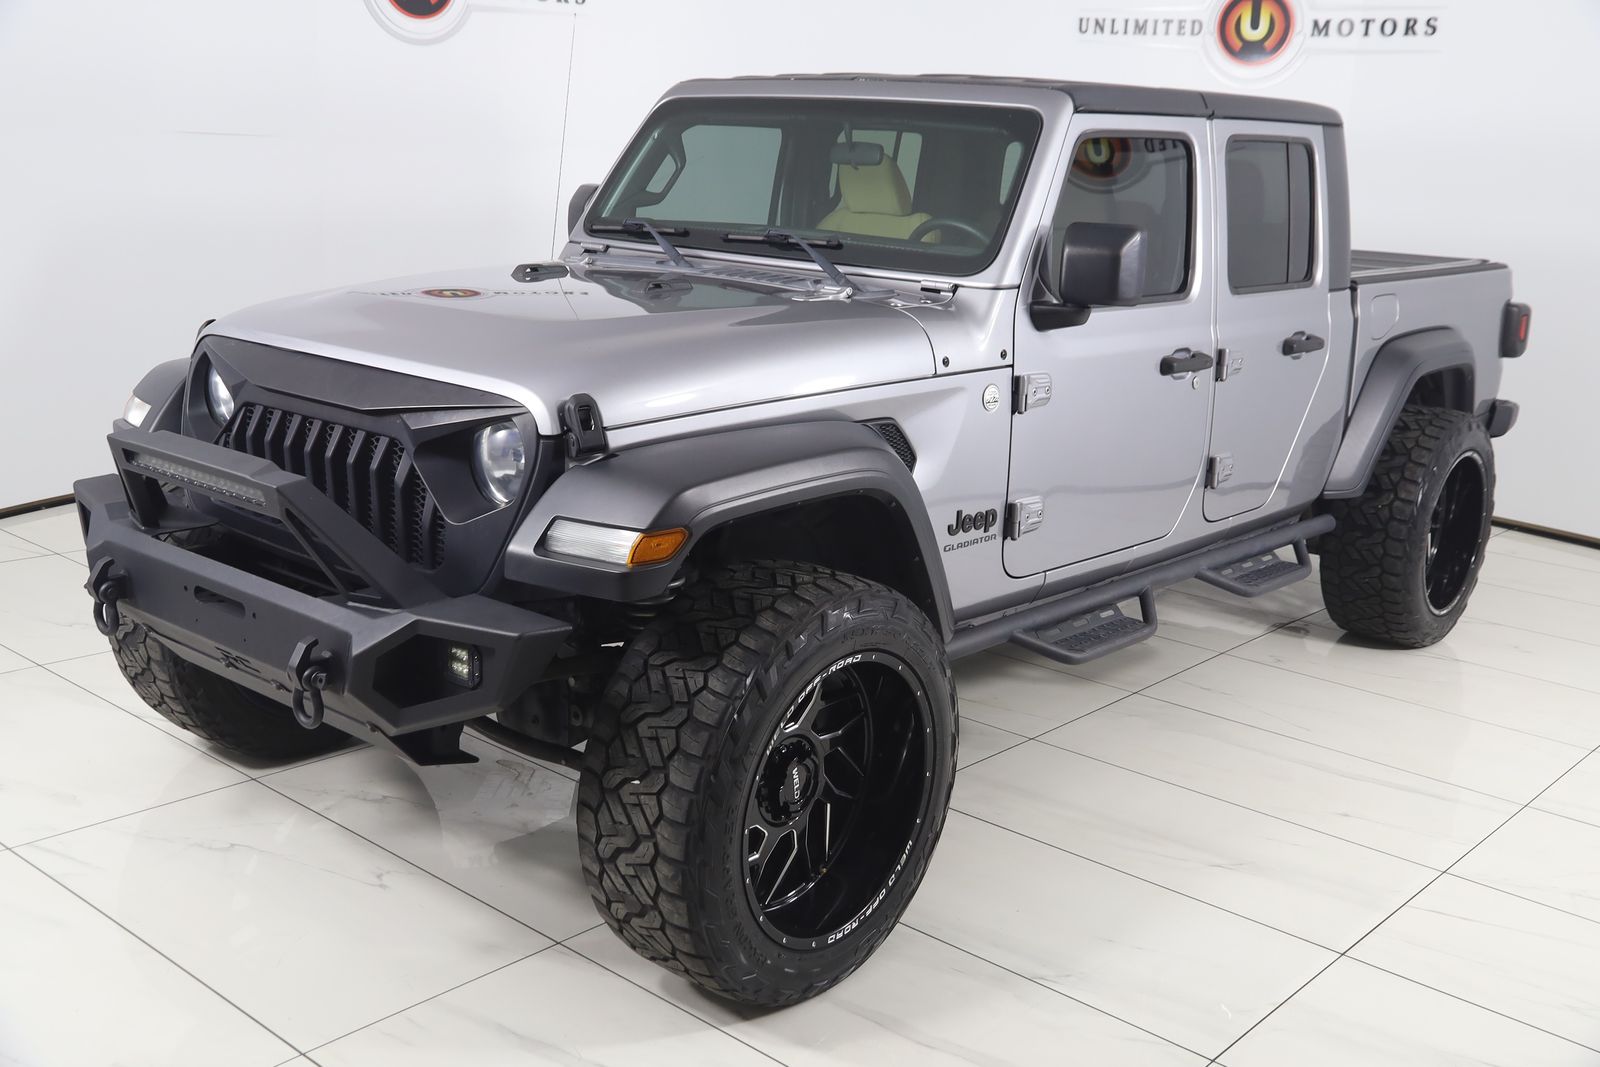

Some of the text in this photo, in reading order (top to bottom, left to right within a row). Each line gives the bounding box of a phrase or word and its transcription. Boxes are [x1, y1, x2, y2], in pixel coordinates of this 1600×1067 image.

[1078, 17, 1204, 36] UNLIMITED
[1310, 16, 1439, 37] MOTORS
[947, 508, 998, 537] Jeep
[943, 533, 997, 553] GLADIATOR
[798, 654, 862, 703] OFF-ROAD
[791, 766, 800, 800] WELD
[827, 840, 913, 944] WELD OFF-ROAD
